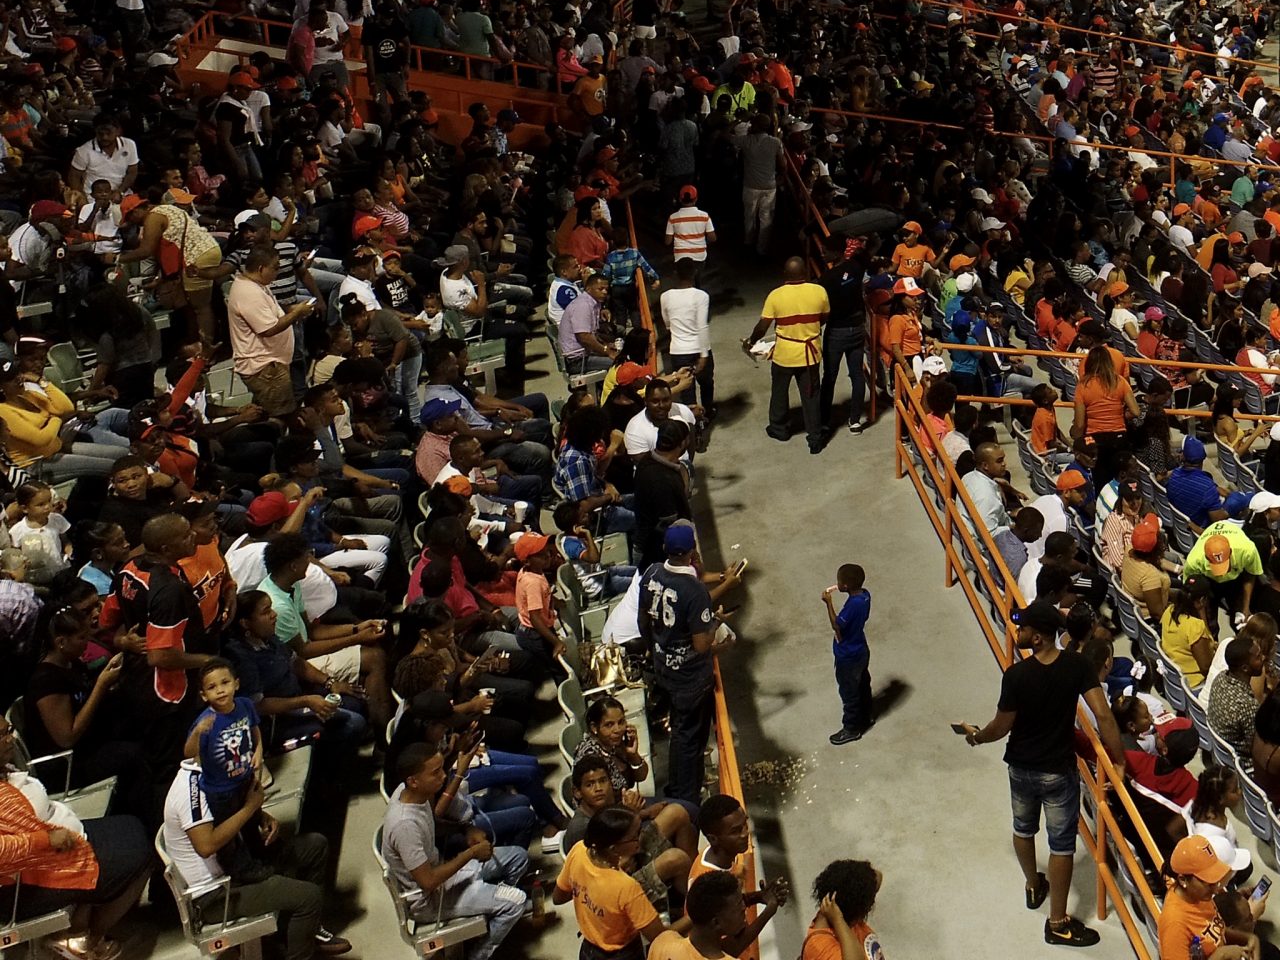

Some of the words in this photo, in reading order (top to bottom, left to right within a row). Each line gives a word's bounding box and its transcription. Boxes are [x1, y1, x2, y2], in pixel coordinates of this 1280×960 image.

[581, 893, 604, 917] SILVA
[215, 940, 223, 949] C
[429, 942, 436, 950] B
